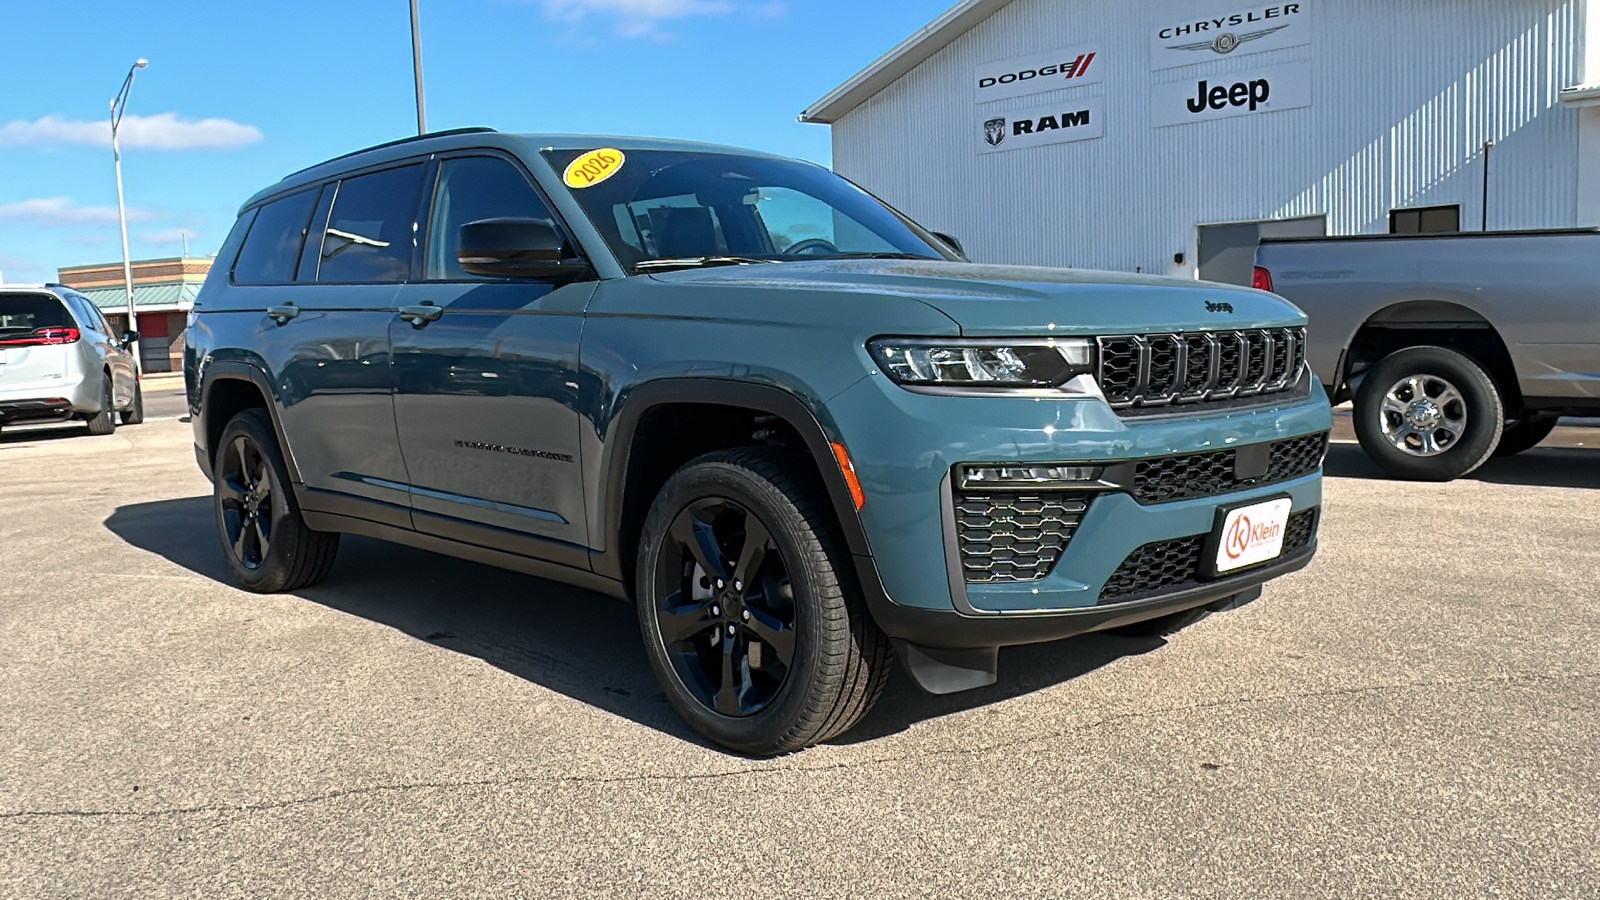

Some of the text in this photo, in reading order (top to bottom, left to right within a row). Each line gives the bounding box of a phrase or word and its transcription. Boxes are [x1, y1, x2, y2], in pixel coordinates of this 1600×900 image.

[1158, 3, 1300, 40] CHRYSLER
[978, 61, 1075, 88] DODGE
[1186, 77, 1270, 114] Jeep
[1012, 109, 1090, 136] RAM
[574, 152, 616, 183] 2026
[1204, 300, 1234, 314] Jeep
[1251, 520, 1280, 543] Klein
